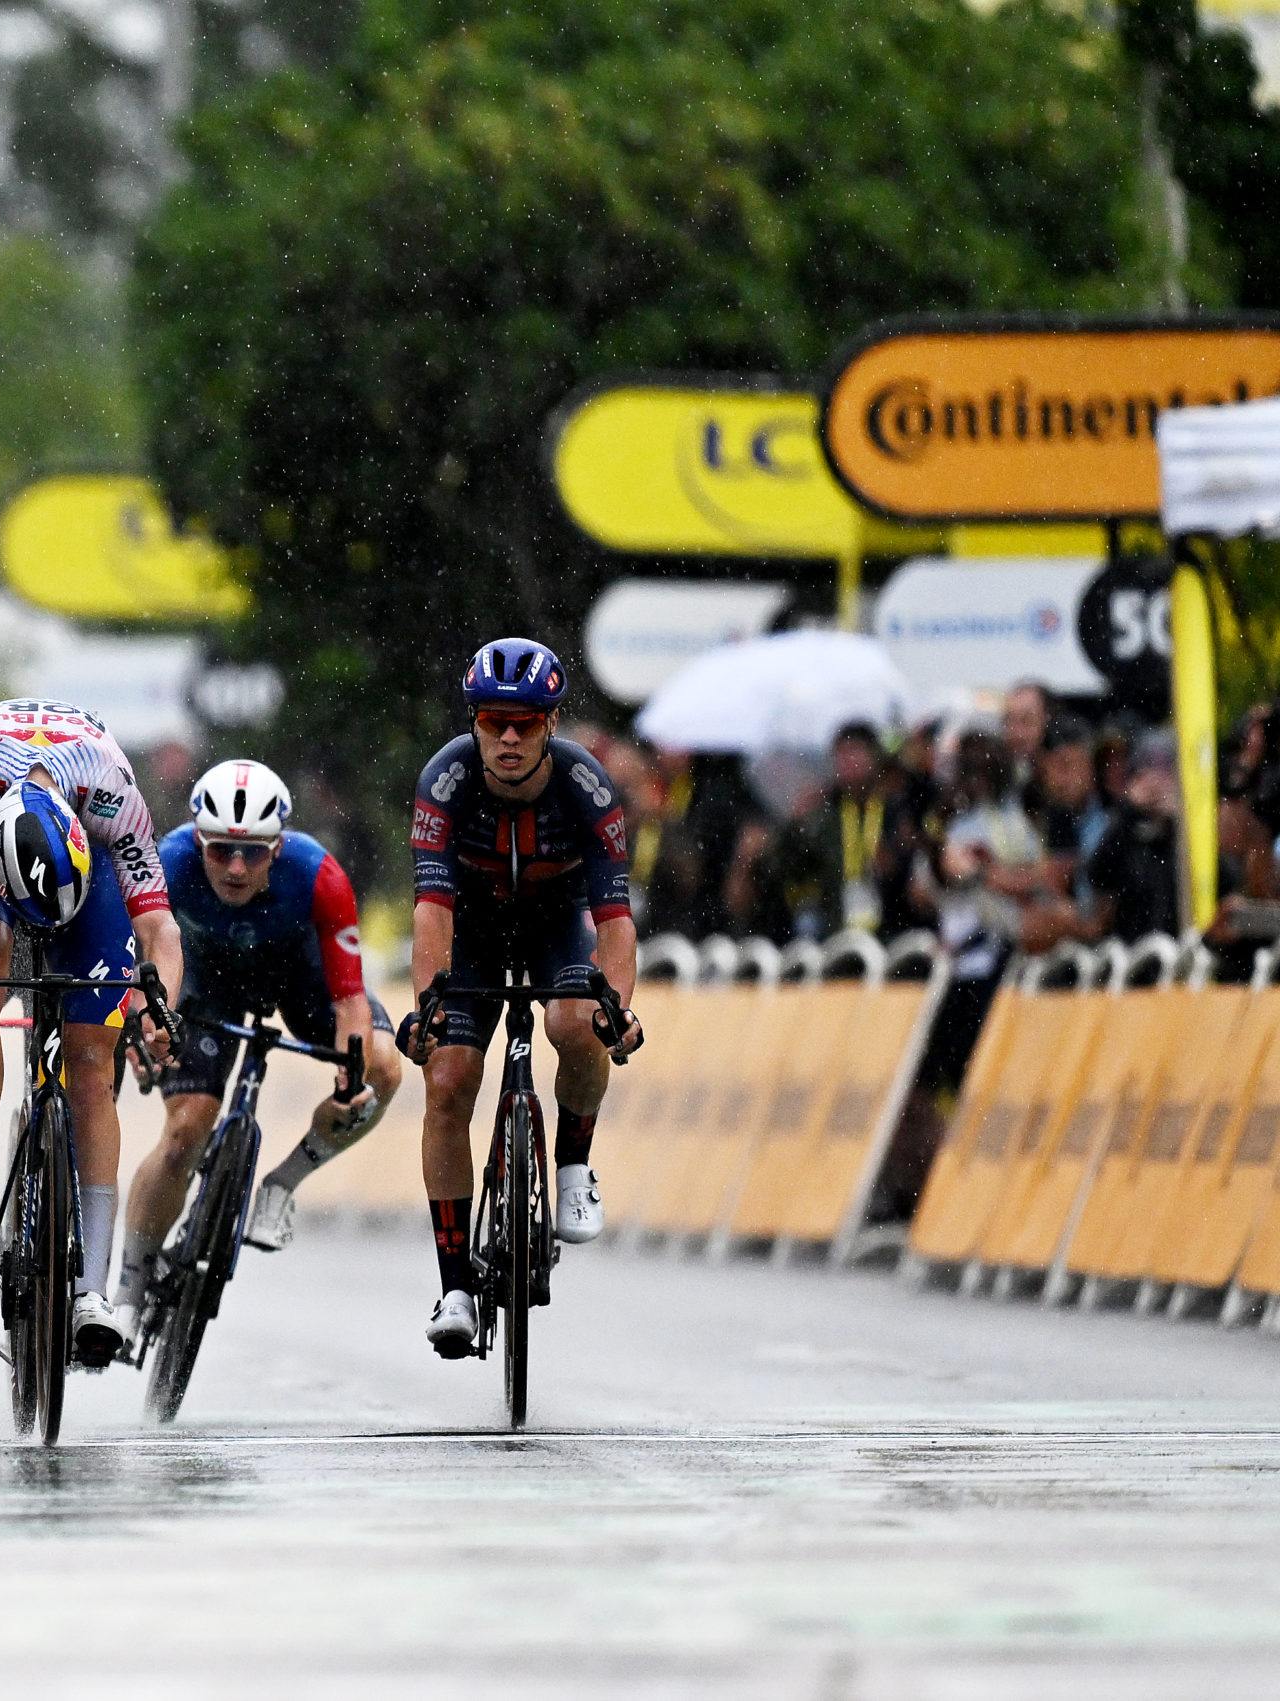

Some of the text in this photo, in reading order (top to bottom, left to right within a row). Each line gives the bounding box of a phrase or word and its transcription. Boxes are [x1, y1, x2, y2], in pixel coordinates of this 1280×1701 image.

[865, 375, 1250, 464] Continen
[527, 651, 545, 684] LAZER
[40, 713, 104, 740] Red
[113, 832, 154, 882] BOSS
[155, 997, 177, 1033] SRAM
